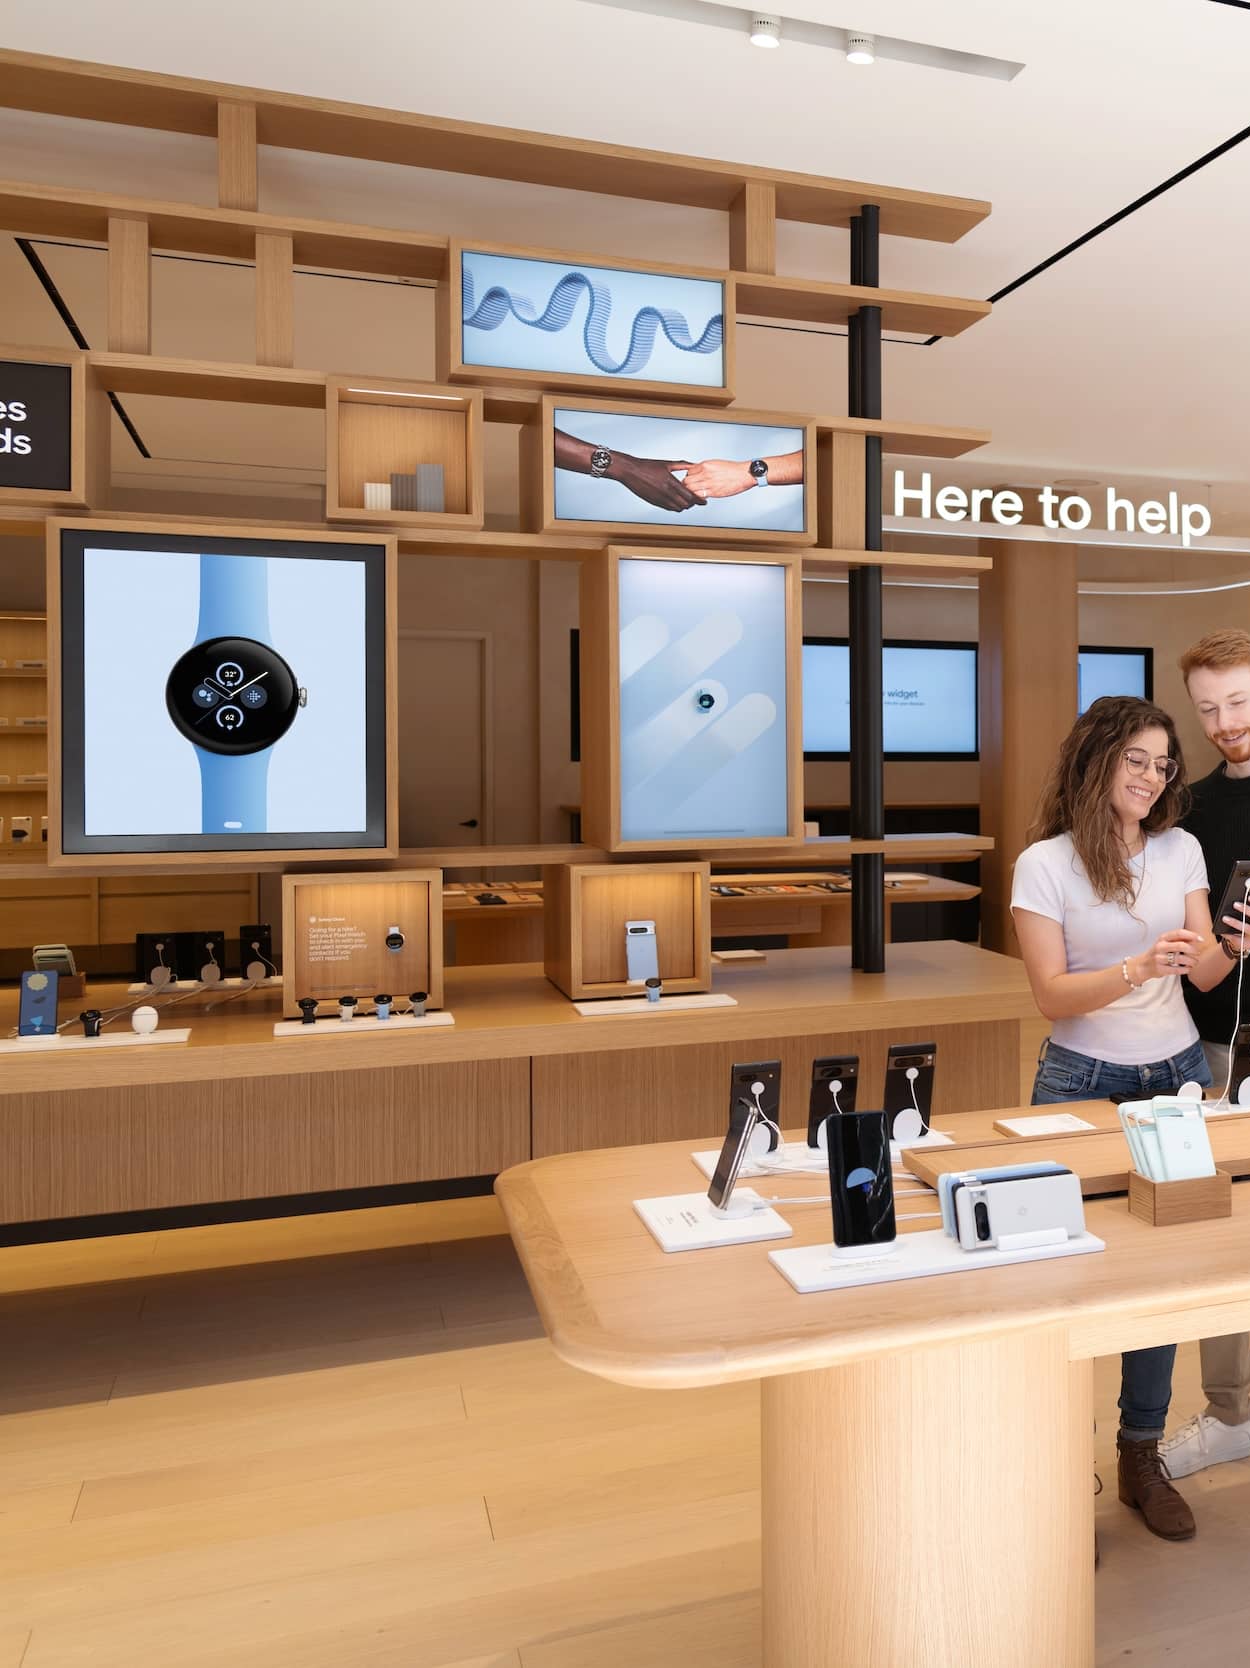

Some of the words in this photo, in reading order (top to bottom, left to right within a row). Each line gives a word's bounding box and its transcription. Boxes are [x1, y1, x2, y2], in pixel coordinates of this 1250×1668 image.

[894, 470, 1024, 525] Here
[1038, 486, 1092, 530] to
[1106, 487, 1212, 546] help
[888, 689, 918, 699] widget
